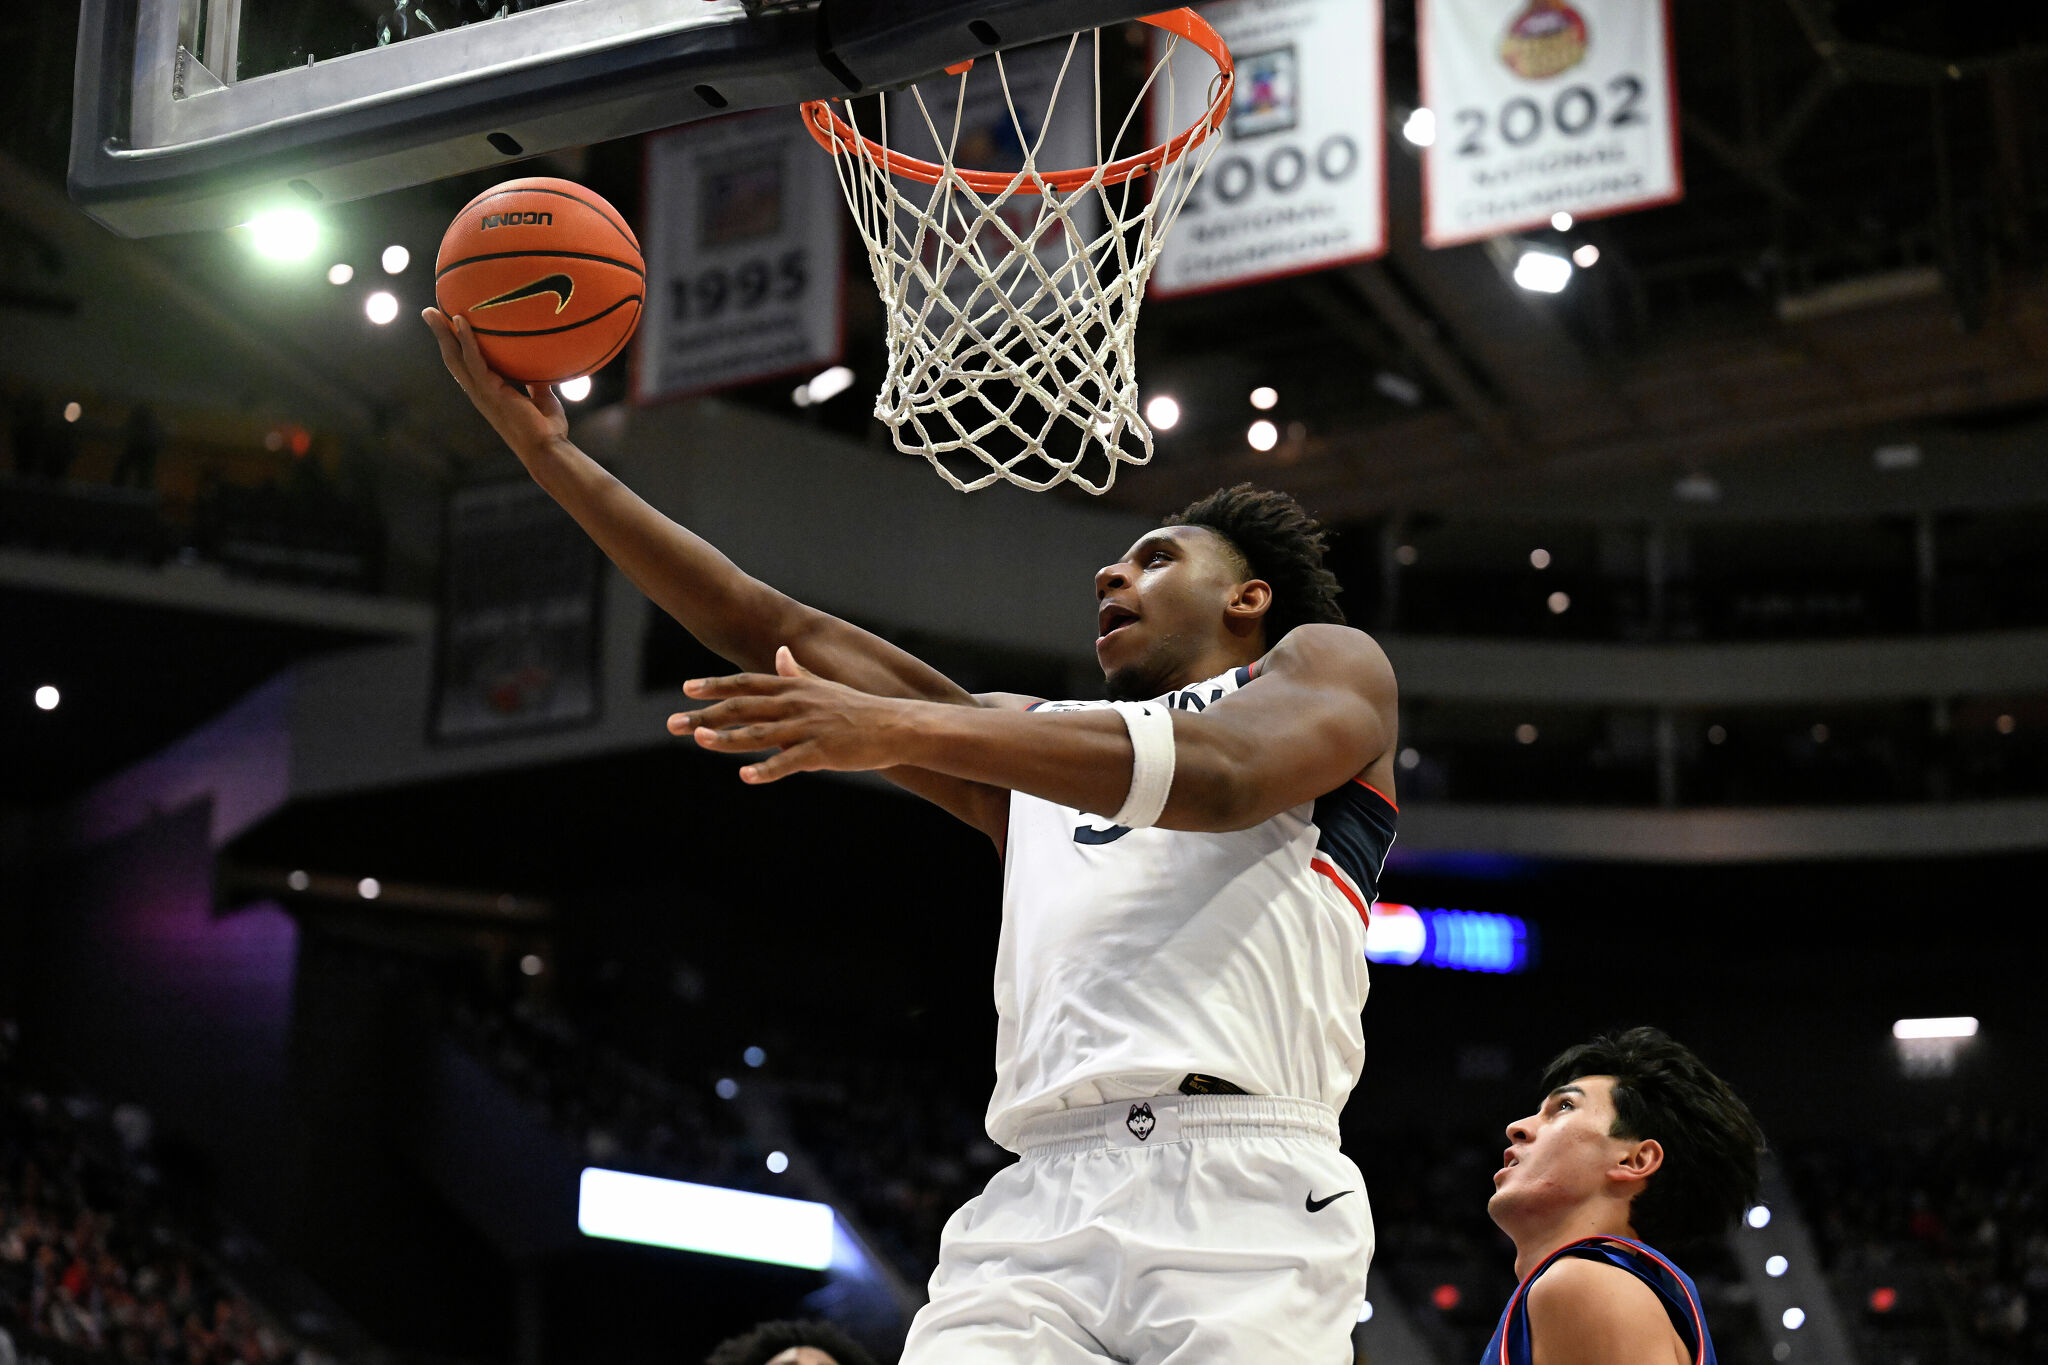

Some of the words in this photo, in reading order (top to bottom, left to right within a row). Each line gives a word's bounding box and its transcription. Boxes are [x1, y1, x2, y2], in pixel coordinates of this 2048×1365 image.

[1454, 74, 1648, 156] 2002
[481, 212, 553, 231] UCONN
[670, 247, 812, 323] 1995
